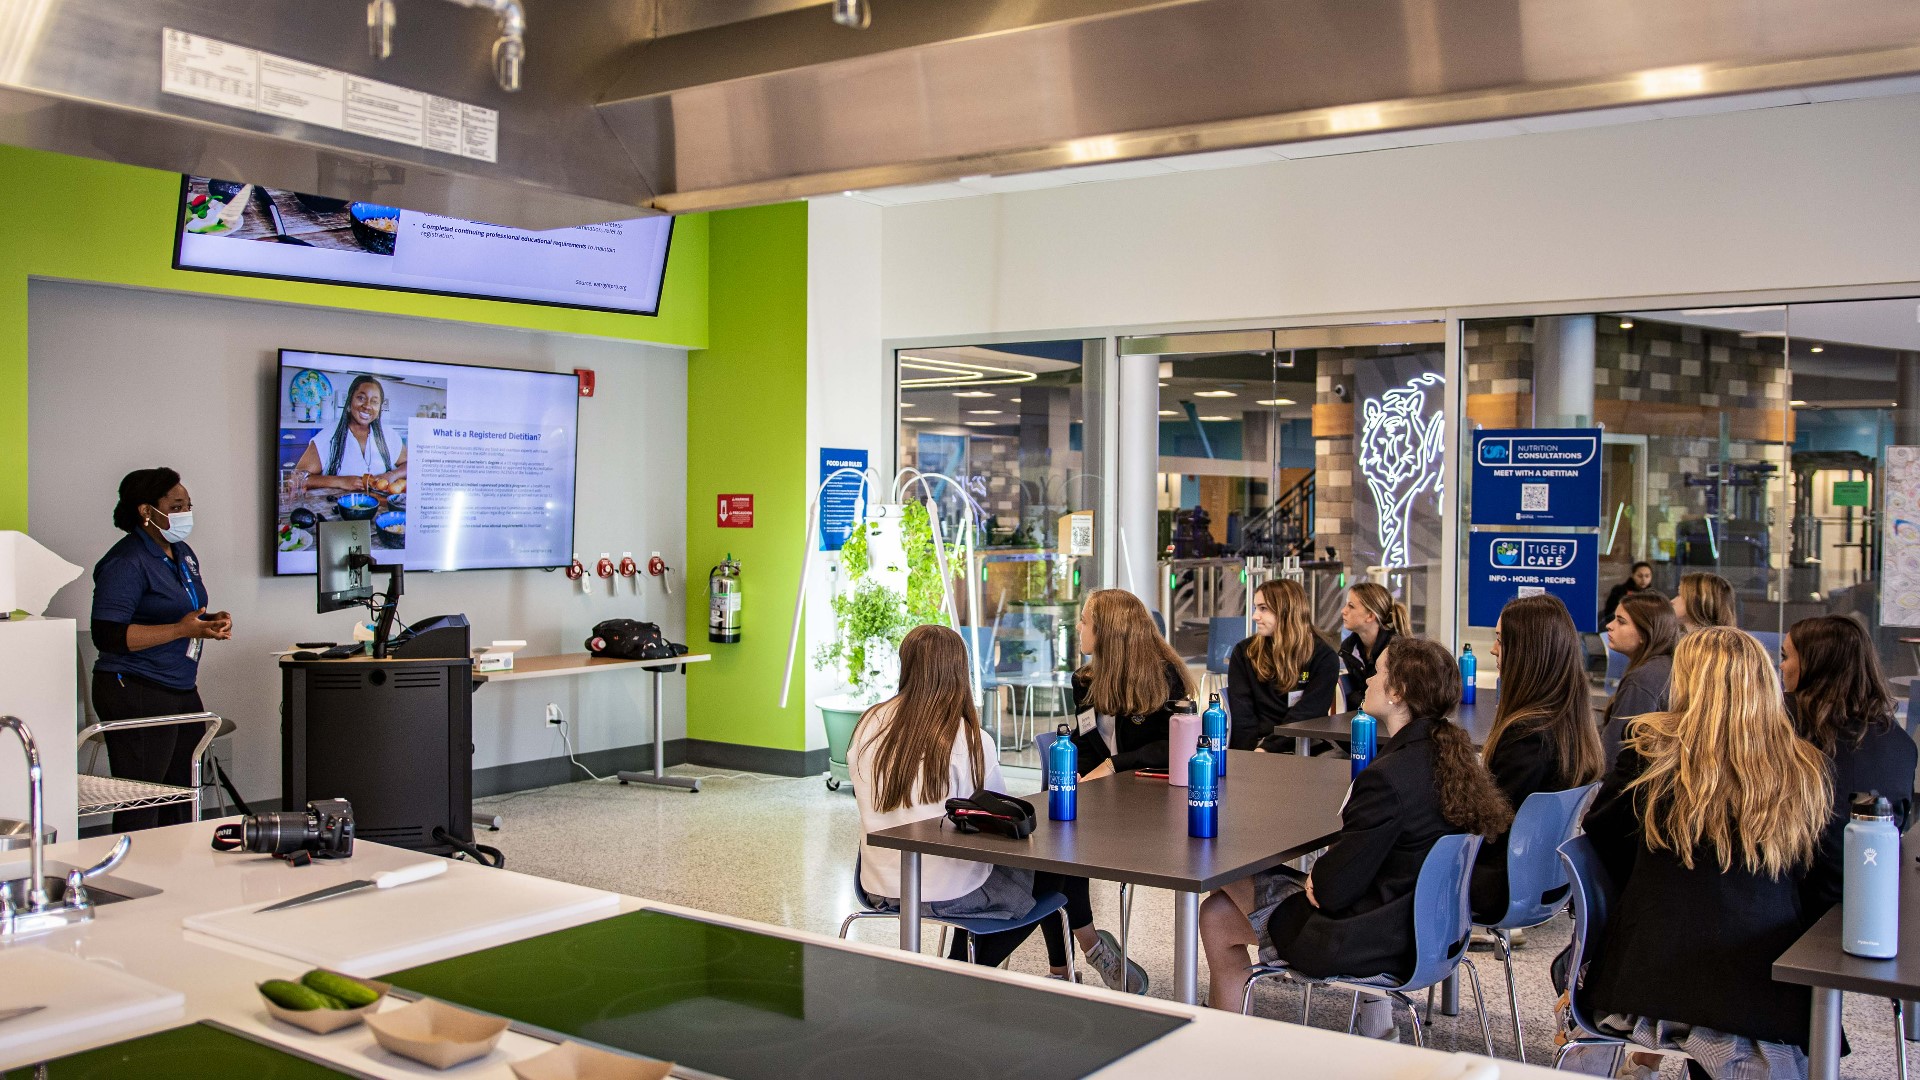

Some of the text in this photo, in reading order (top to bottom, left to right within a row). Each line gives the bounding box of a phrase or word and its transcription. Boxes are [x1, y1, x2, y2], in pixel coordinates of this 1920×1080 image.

[422, 223, 454, 232] Completed
[485, 231, 520, 241] professional
[433, 428, 453, 437] What
[455, 429, 460, 437] is
[469, 430, 507, 440] Registered
[508, 432, 541, 441] Dietitian?
[1518, 452, 1582, 460] CONSULTATIONS
[1494, 469, 1513, 477] MEET
[1515, 469, 1534, 477] WITH
[1542, 469, 1579, 477] DIETITIAN
[1528, 544, 1567, 555] TIGER
[1527, 555, 1563, 566] CAFÉ
[1489, 574, 1507, 582] INFO
